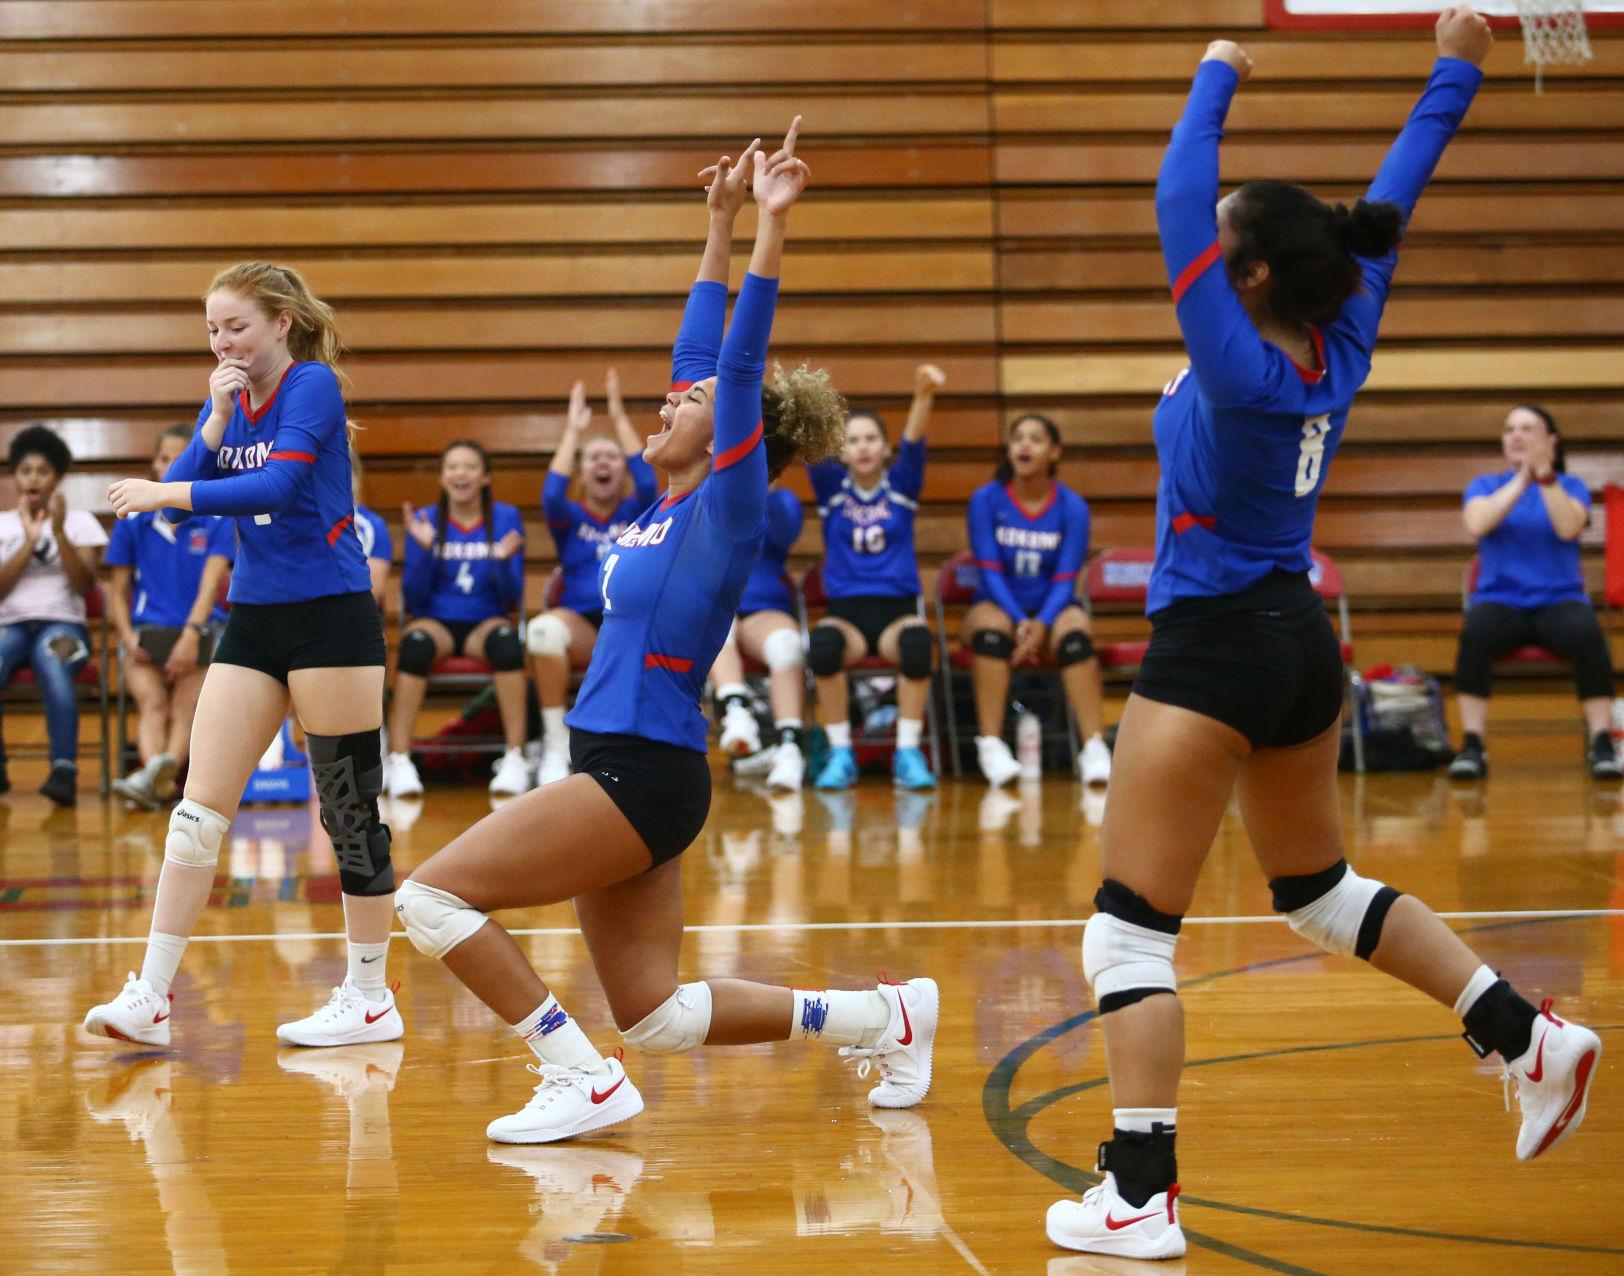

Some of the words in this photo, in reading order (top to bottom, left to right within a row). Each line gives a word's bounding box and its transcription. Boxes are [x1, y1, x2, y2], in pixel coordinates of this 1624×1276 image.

[217, 440, 274, 470] OKOM
[1295, 413, 1330, 497] 8
[455, 560, 474, 594] 4
